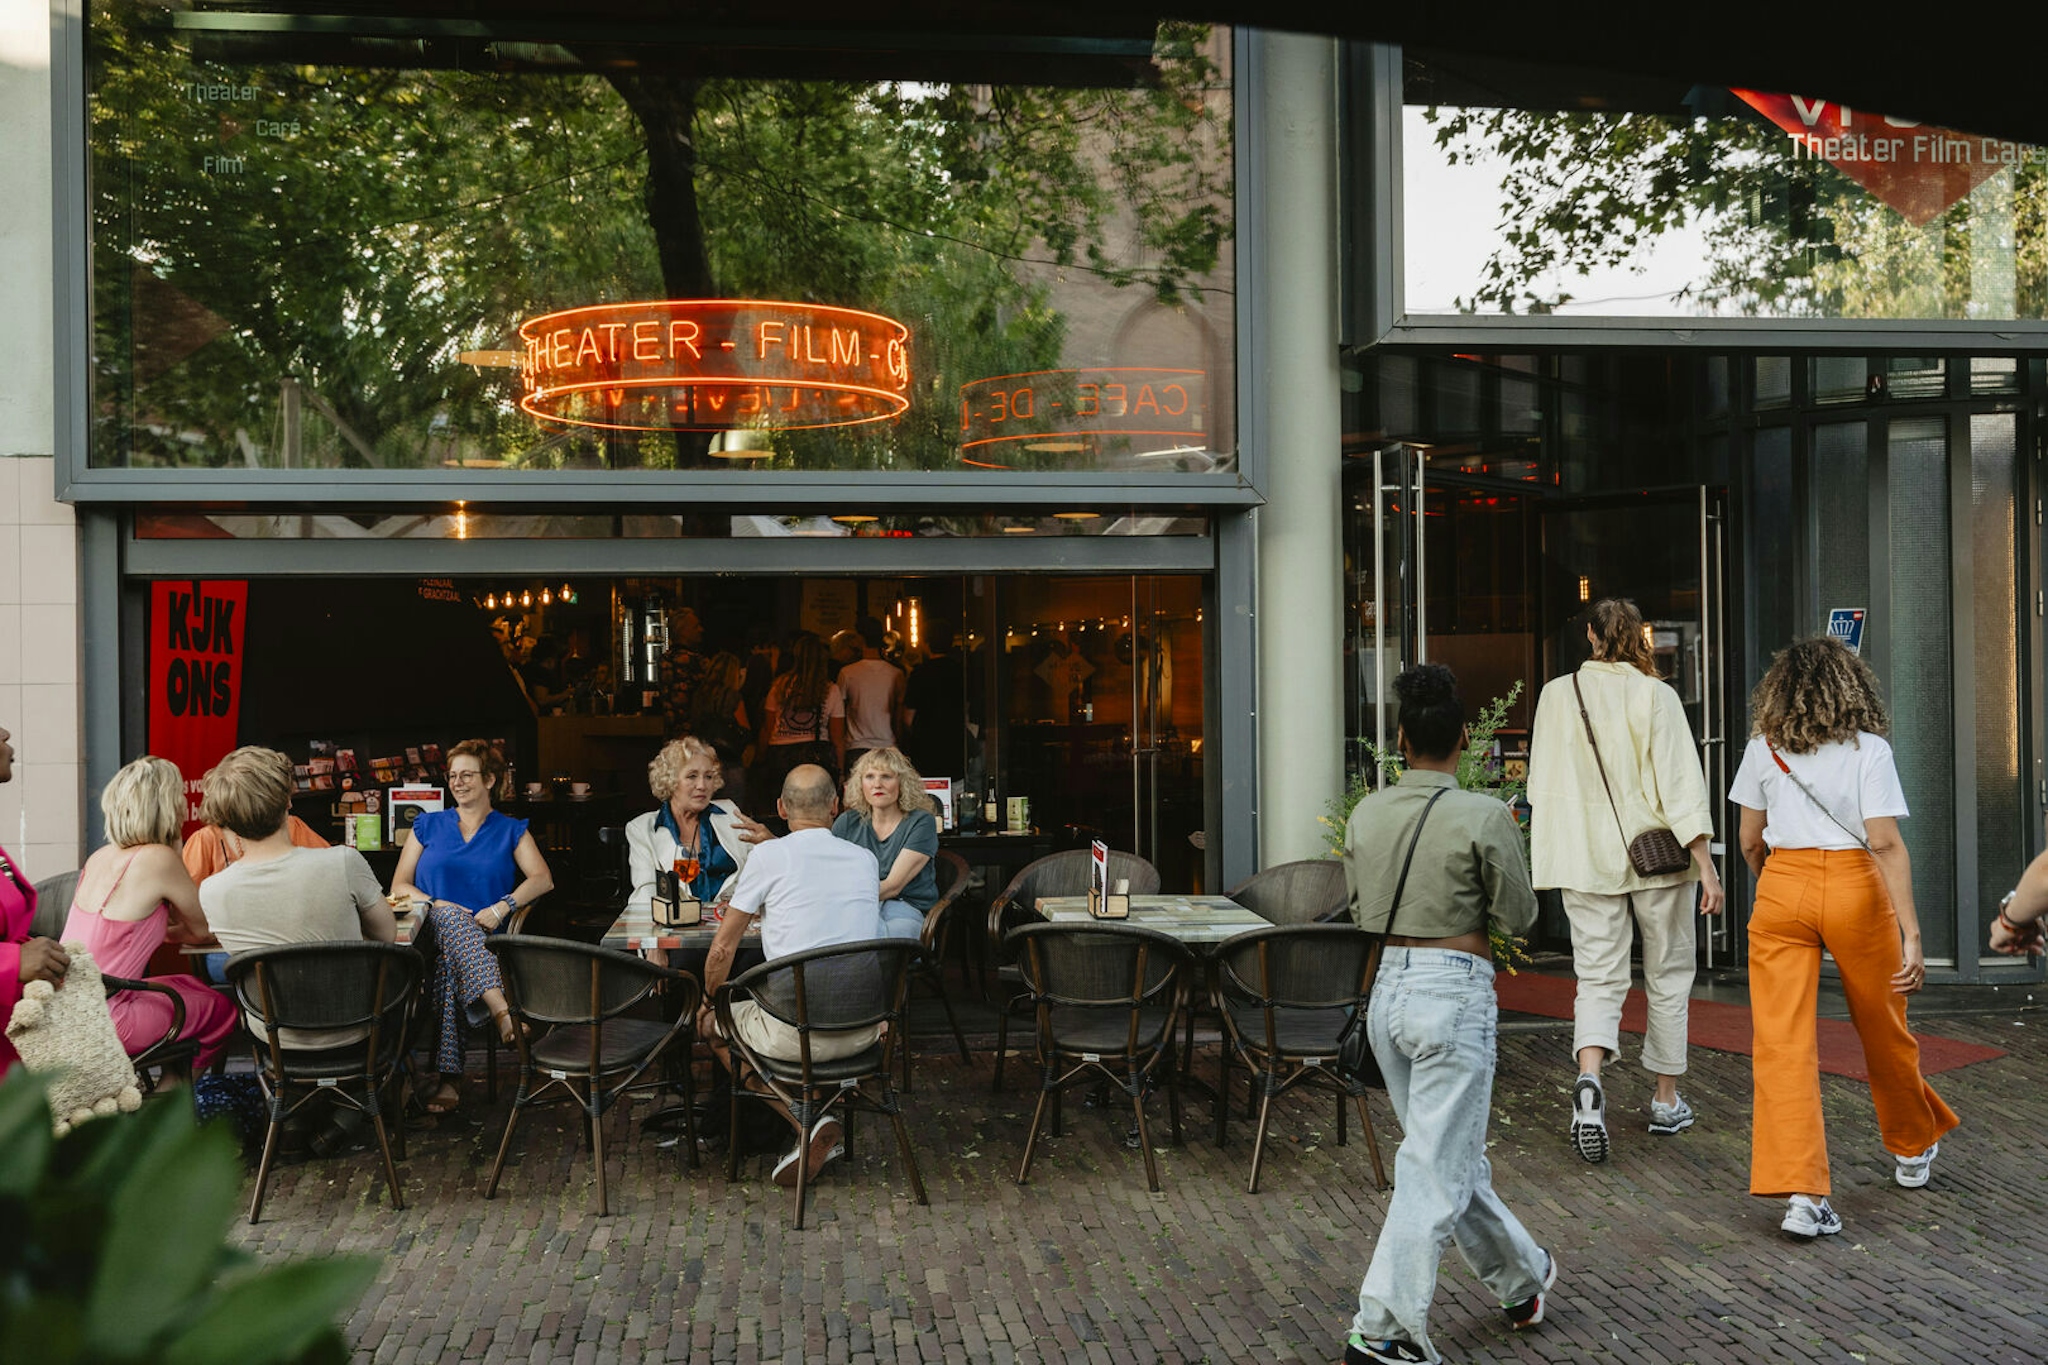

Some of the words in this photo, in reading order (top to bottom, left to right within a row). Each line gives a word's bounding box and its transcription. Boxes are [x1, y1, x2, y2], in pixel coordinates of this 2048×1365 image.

[184, 82, 262, 101] Theater
[256, 118, 301, 140] Café
[1787, 131, 1905, 163] Theater
[1914, 134, 1971, 164] Film
[204, 156, 244, 174] Film
[525, 320, 701, 375] THEATER
[760, 321, 861, 367] FILM
[166, 657, 231, 718] ONS
